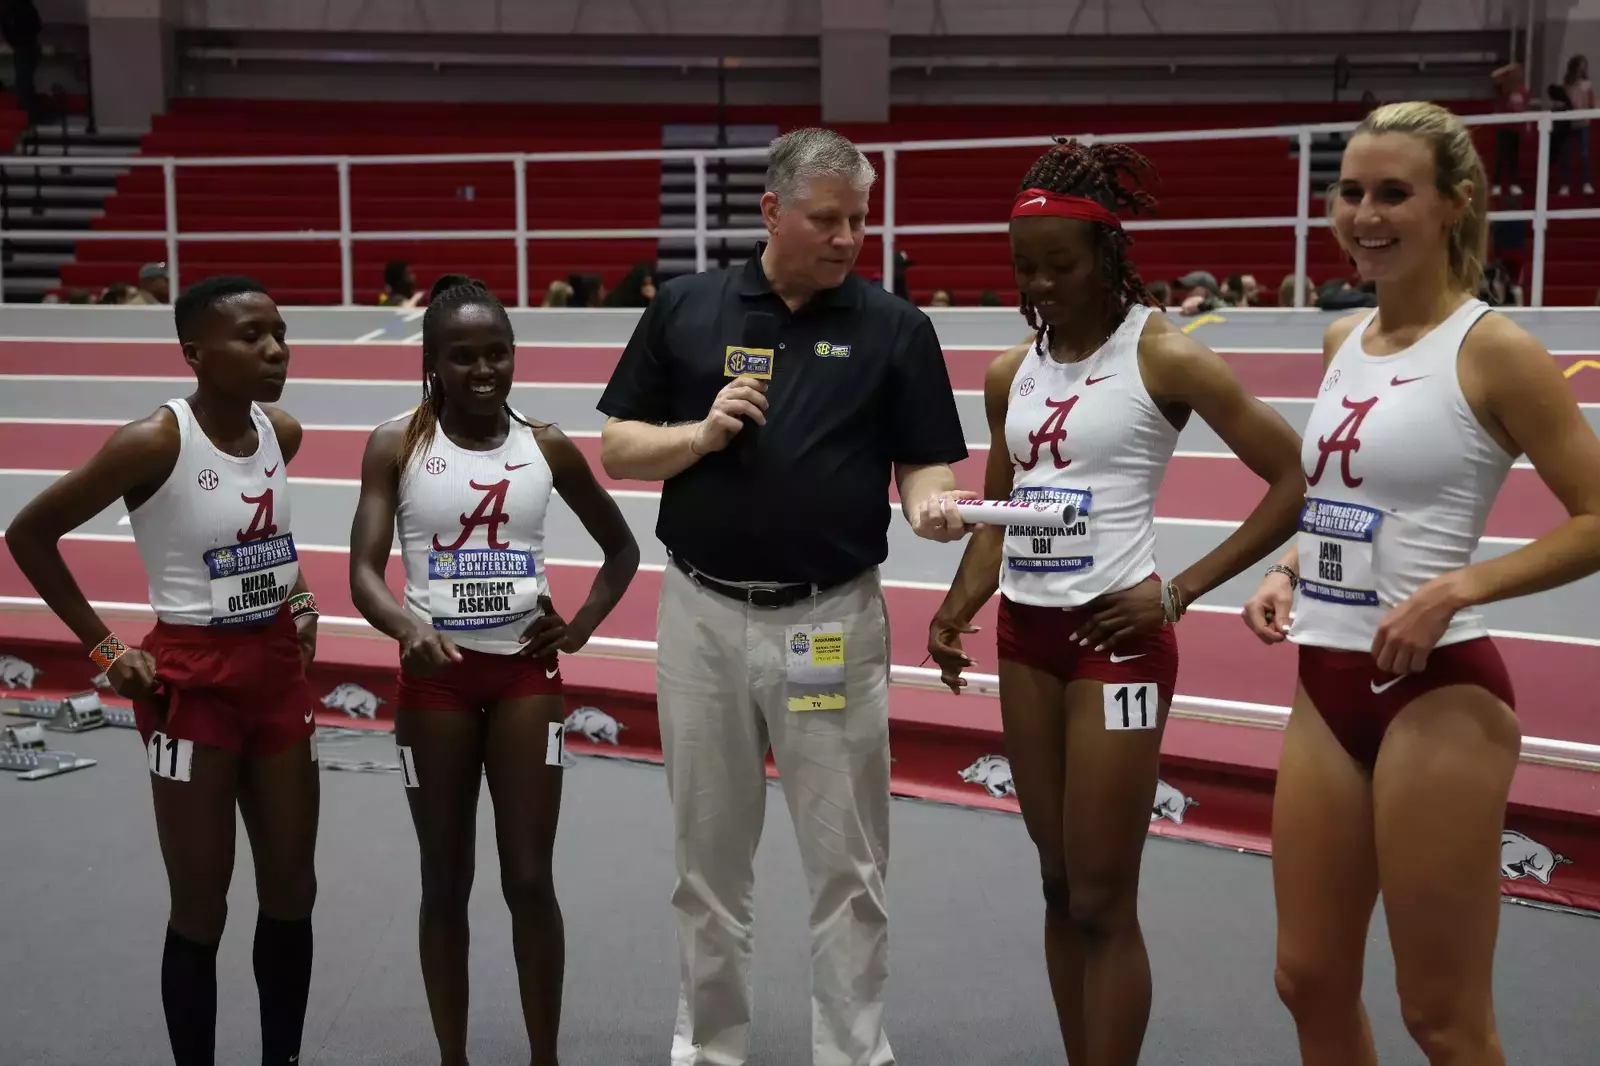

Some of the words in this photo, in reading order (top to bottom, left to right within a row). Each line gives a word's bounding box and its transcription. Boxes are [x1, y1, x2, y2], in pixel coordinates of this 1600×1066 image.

[817, 344, 830, 354] SEC
[730, 353, 746, 372] SEC
[427, 458, 446, 474] SEC
[199, 470, 218, 490] SEC
[1026, 490, 1084, 502] SOUTHEASTERN
[432, 478, 510, 551] A
[1318, 504, 1375, 523] SOUTHEASTERN
[1316, 515, 1370, 532] CONFERENCE
[237, 539, 289, 558] SOUTHEASTERN
[1032, 538, 1052, 554] OBI
[1319, 541, 1342, 562] JAMI
[238, 546, 292, 567] CONFERENCE
[459, 552, 526, 562] SOUTHEASTERN
[460, 562, 528, 571] CONFERENCE
[1319, 561, 1342, 582] REED
[241, 572, 276, 593] HILDA
[452, 582, 516, 598] FLOMENA
[228, 584, 288, 612] OLEMOMOI
[458, 596, 510, 614] ASEKOL
[246, 613, 261, 622] TYSON
[1114, 686, 1147, 727] 11
[555, 726, 563, 764] 1
[153, 734, 178, 777] 11
